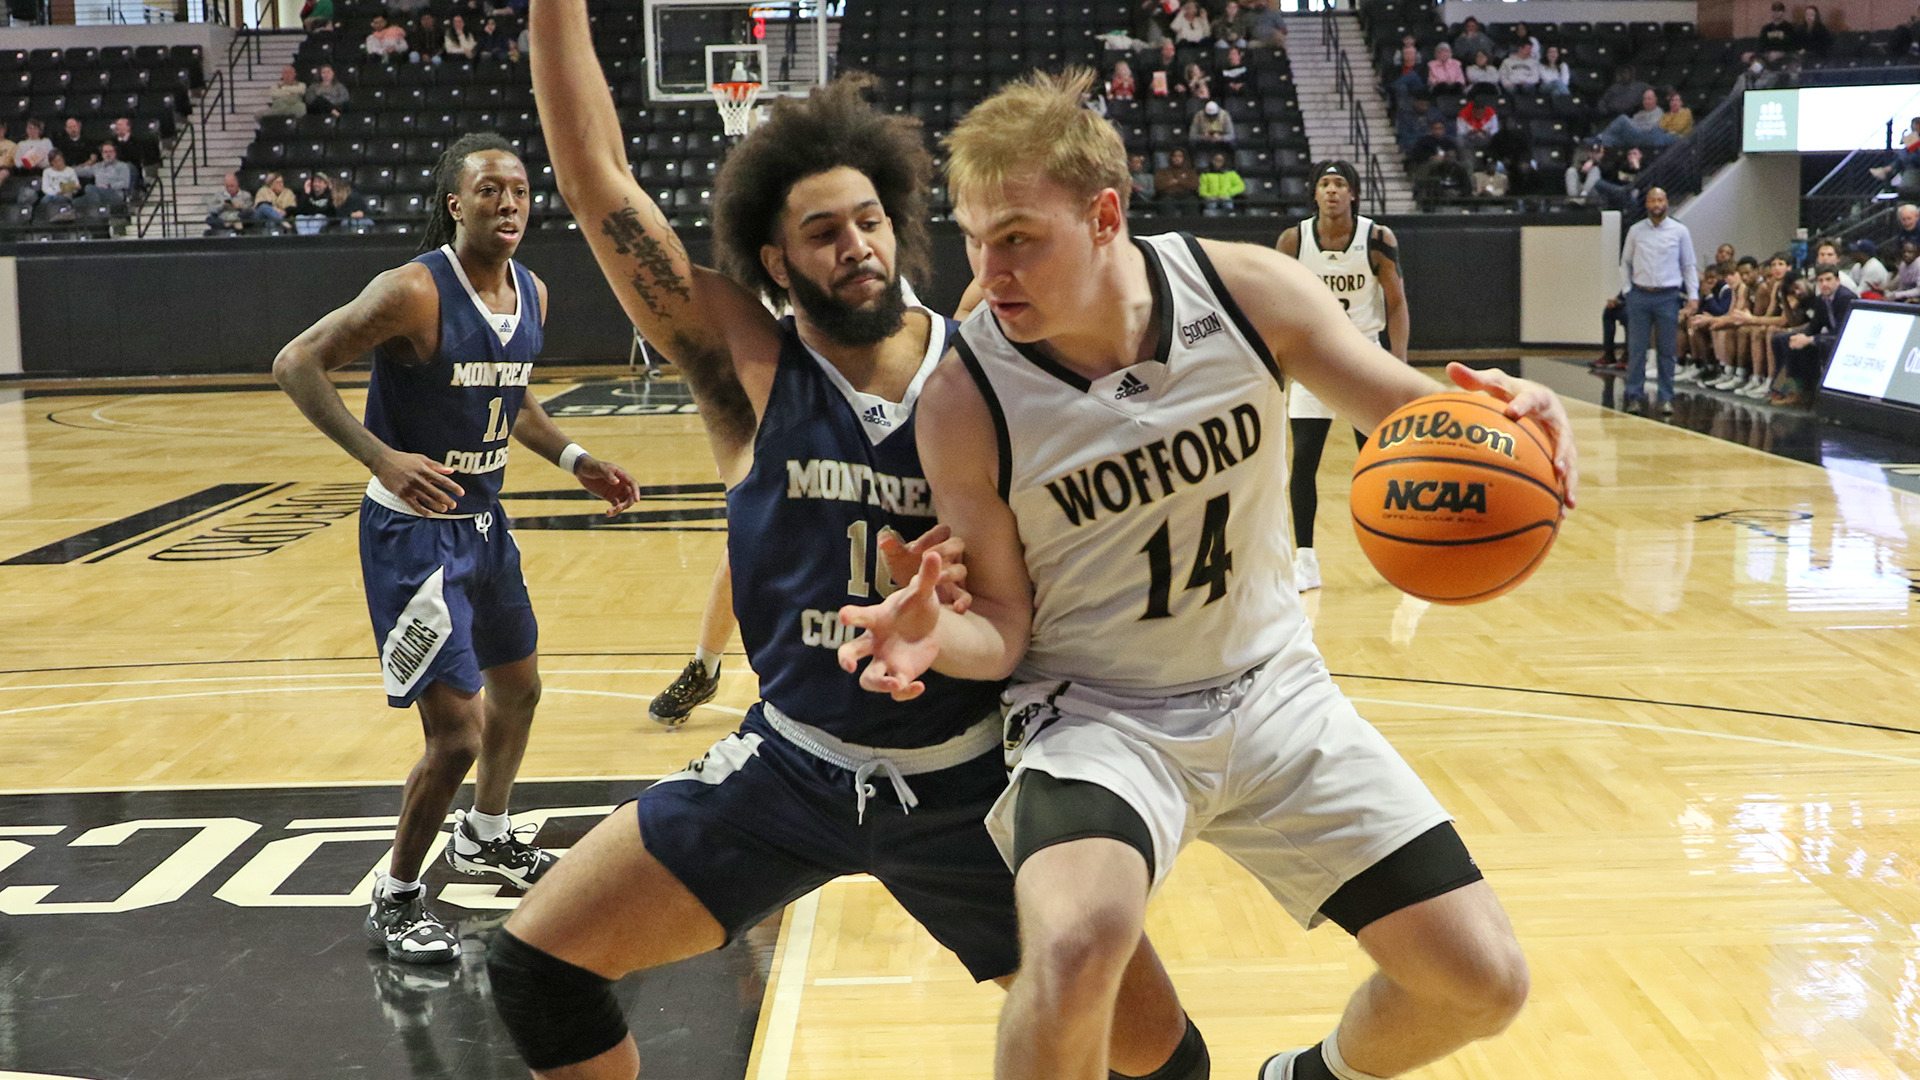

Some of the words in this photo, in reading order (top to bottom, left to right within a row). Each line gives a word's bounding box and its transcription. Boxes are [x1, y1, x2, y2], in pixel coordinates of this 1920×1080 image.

[1321, 274, 1366, 292] FFORD
[451, 362, 533, 387] MONTREA
[1114, 382, 1149, 401] adidas
[862, 414, 892, 427] adidas
[1377, 410, 1516, 460] Wilson
[1044, 402, 1261, 527] WOFFORD
[786, 459, 938, 518] MONTRE
[1383, 479, 1487, 513] NCAA
[1135, 491, 1233, 622] 14
[388, 618, 439, 685] CAVALIERS
